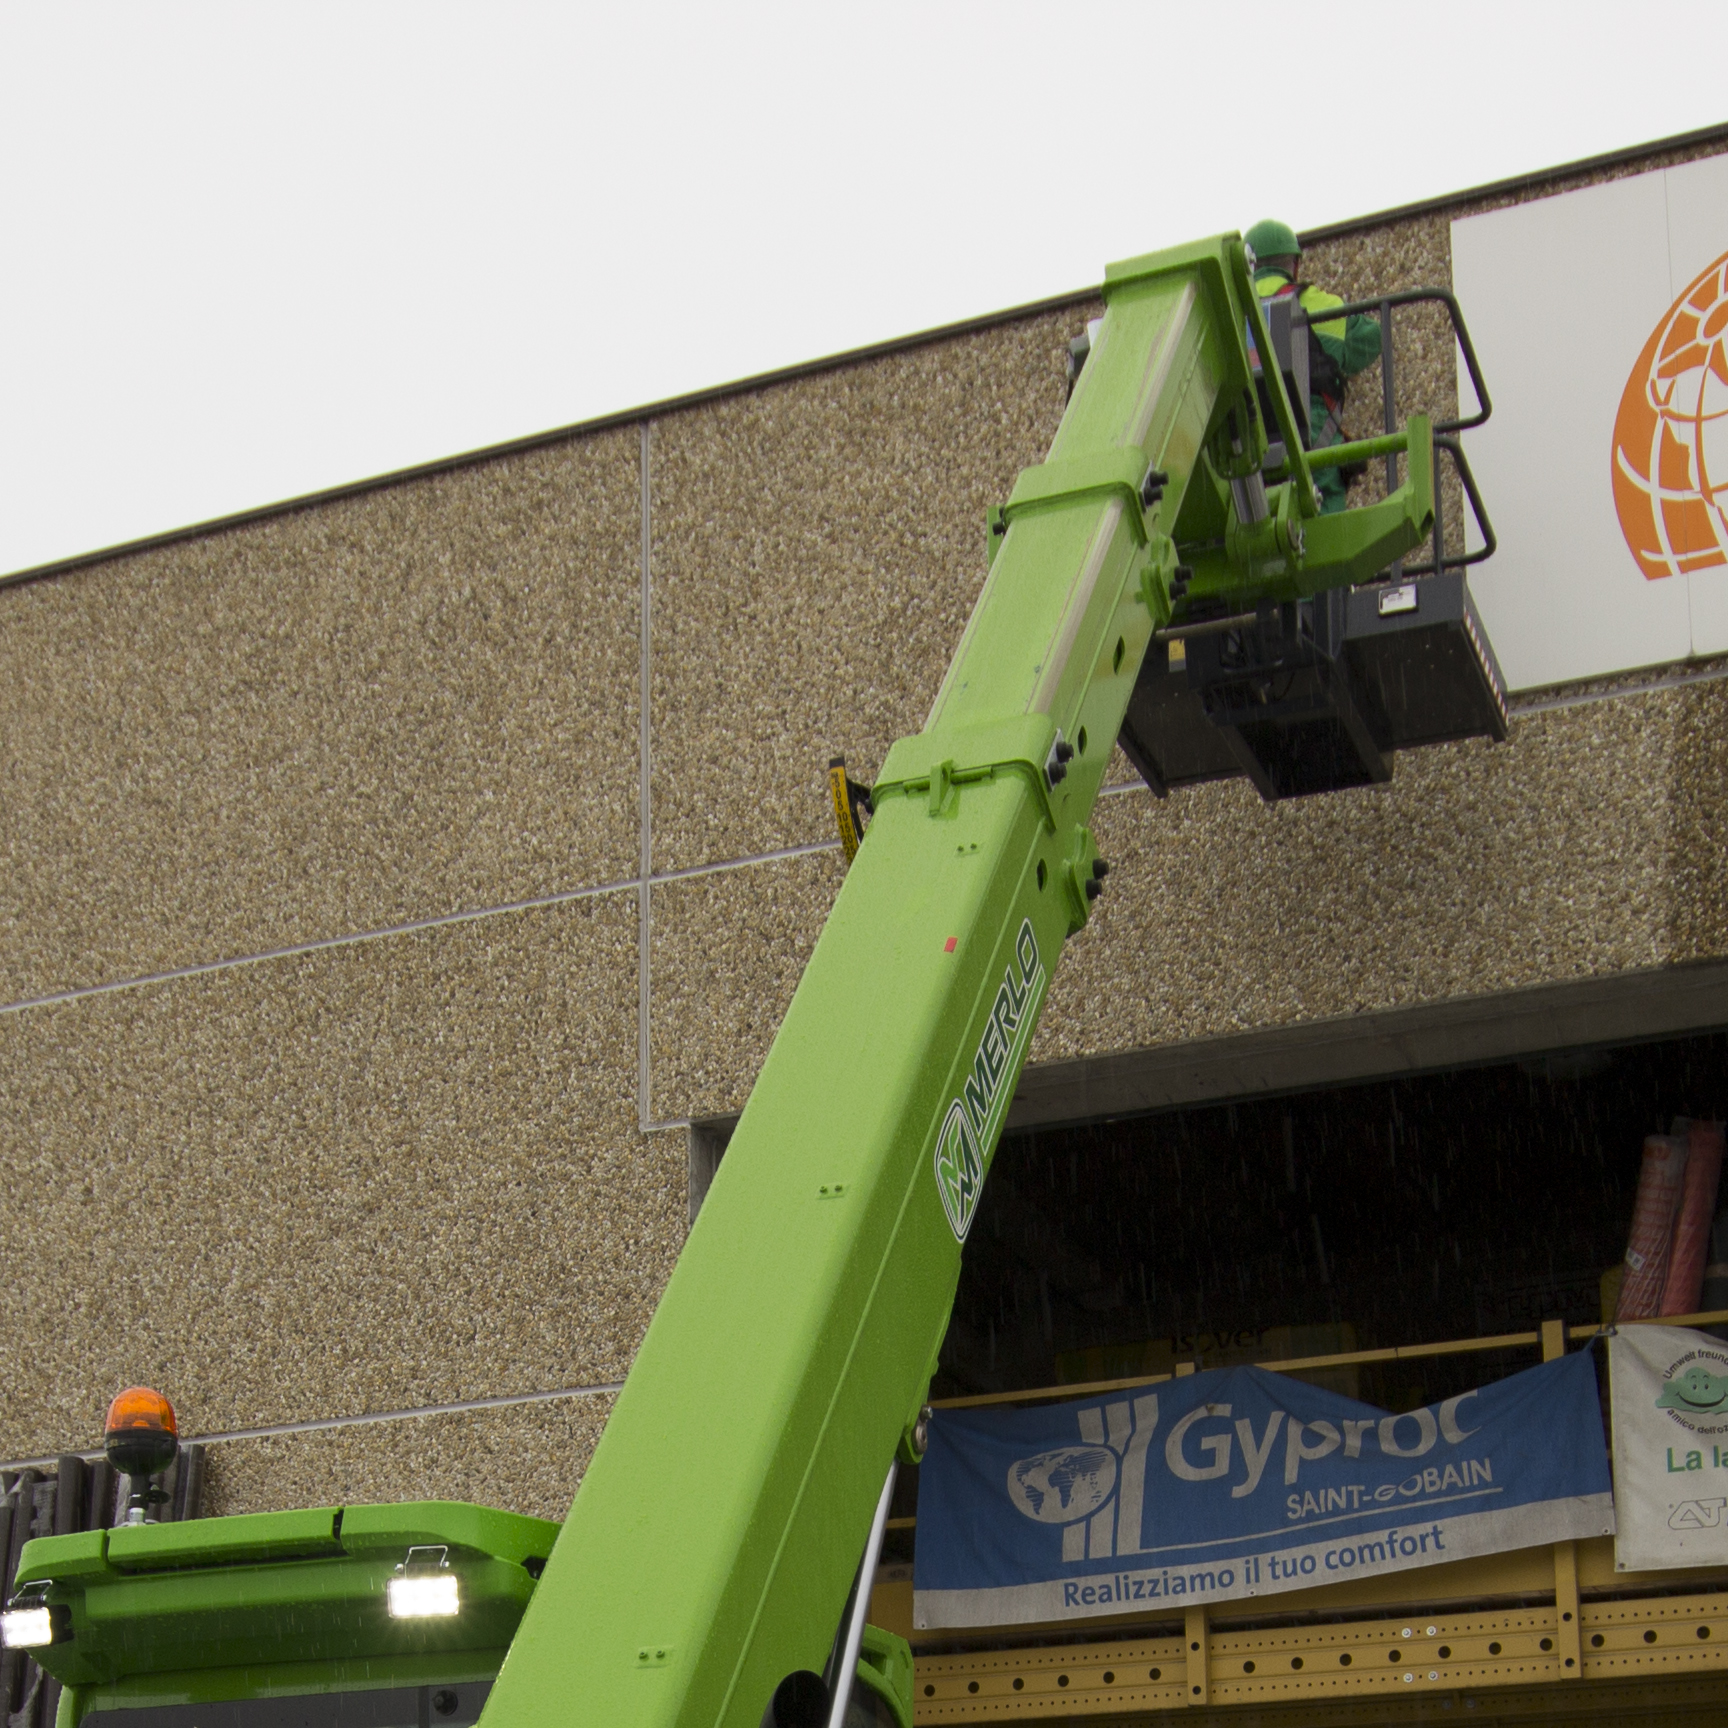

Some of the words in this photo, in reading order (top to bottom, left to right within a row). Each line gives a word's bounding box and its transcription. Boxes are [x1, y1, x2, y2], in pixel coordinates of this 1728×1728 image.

[964, 917, 1039, 1138] MERLO
[1165, 1390, 1483, 1499] Gyproc
[1667, 1409, 1695, 1430] amico
[1286, 1457, 1493, 1520] SAINT-GOBAIN
[1667, 1447, 1702, 1473] La
[1064, 1567, 1235, 1608] Realizziamo
[1245, 1558, 1262, 1584] il
[1269, 1553, 1318, 1580] tuo
[1325, 1525, 1446, 1570] comfort
